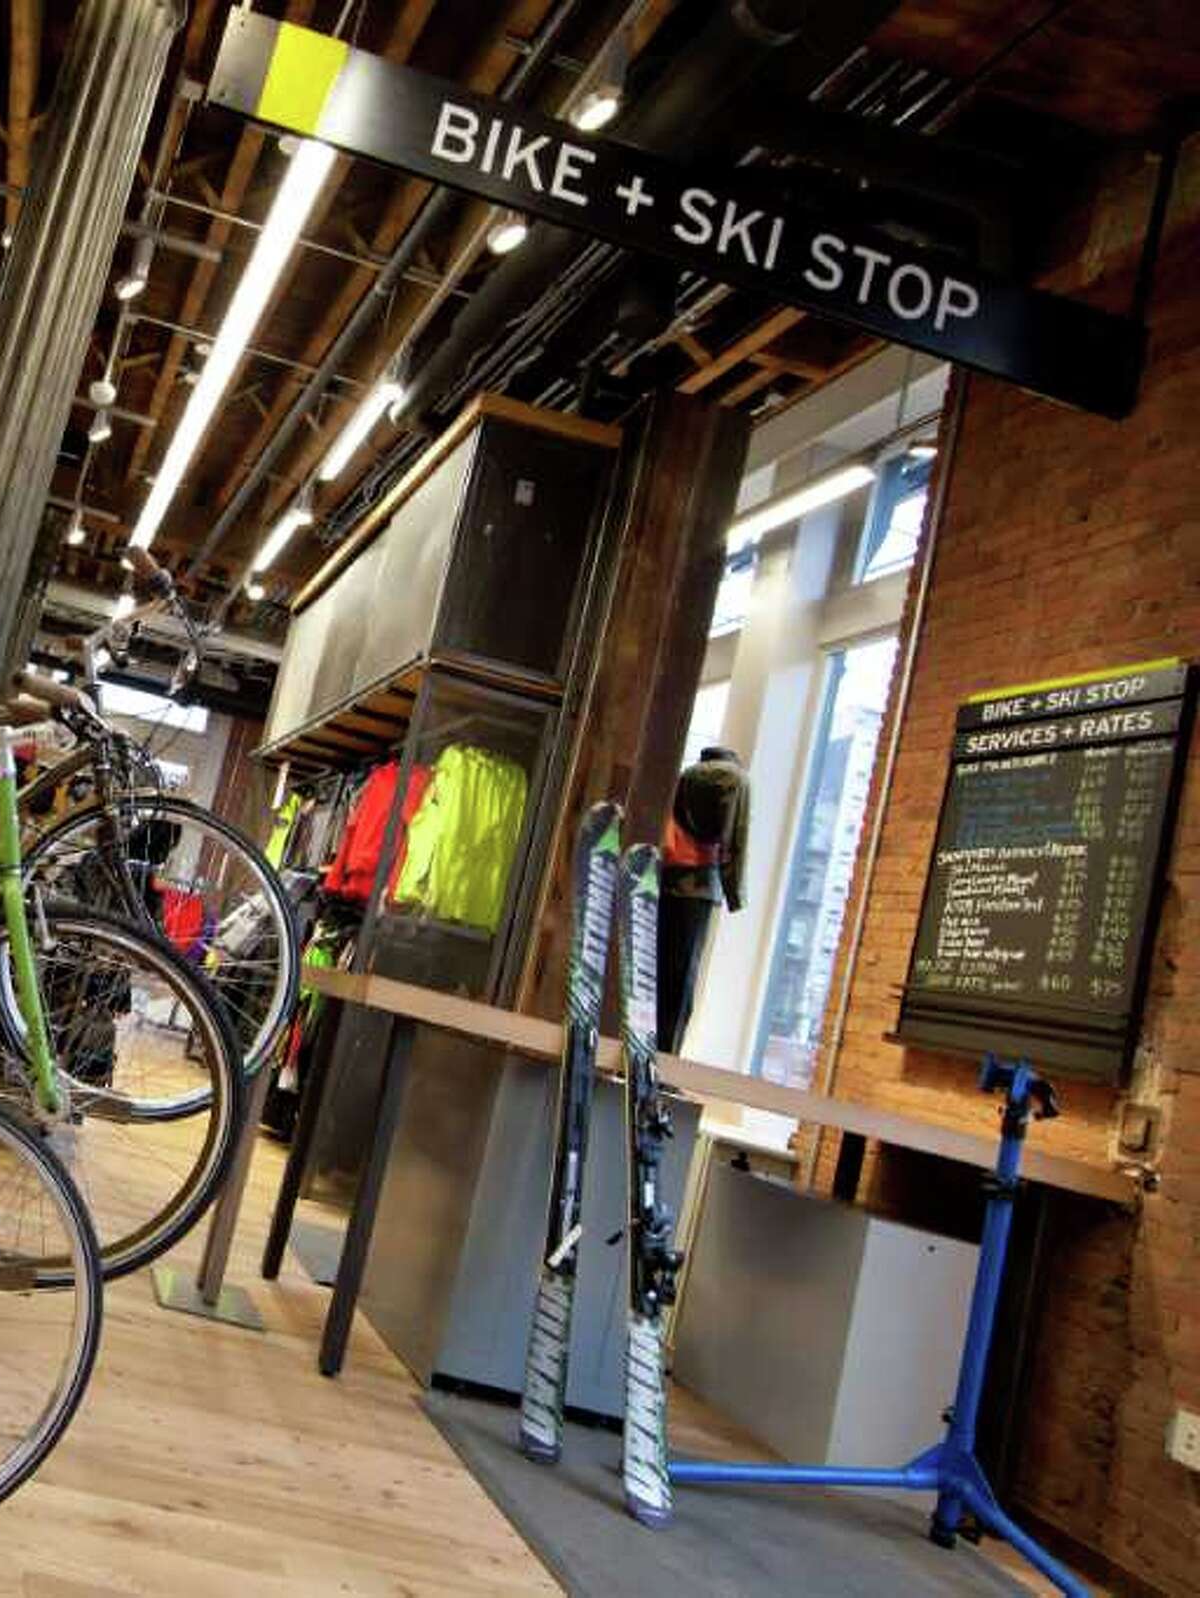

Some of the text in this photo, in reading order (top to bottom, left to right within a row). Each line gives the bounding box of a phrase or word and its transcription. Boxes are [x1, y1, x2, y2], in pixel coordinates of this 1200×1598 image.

[430, 102, 980, 331] BIKE + SKI STOP
[966, 725, 1056, 753] SERVICES
[1079, 711, 1153, 738] RATES
[982, 697, 1025, 722] BIKE
[1045, 690, 1080, 711] SKI
[1087, 677, 1145, 704] STOP
[581, 854, 616, 976] ATOMIC
